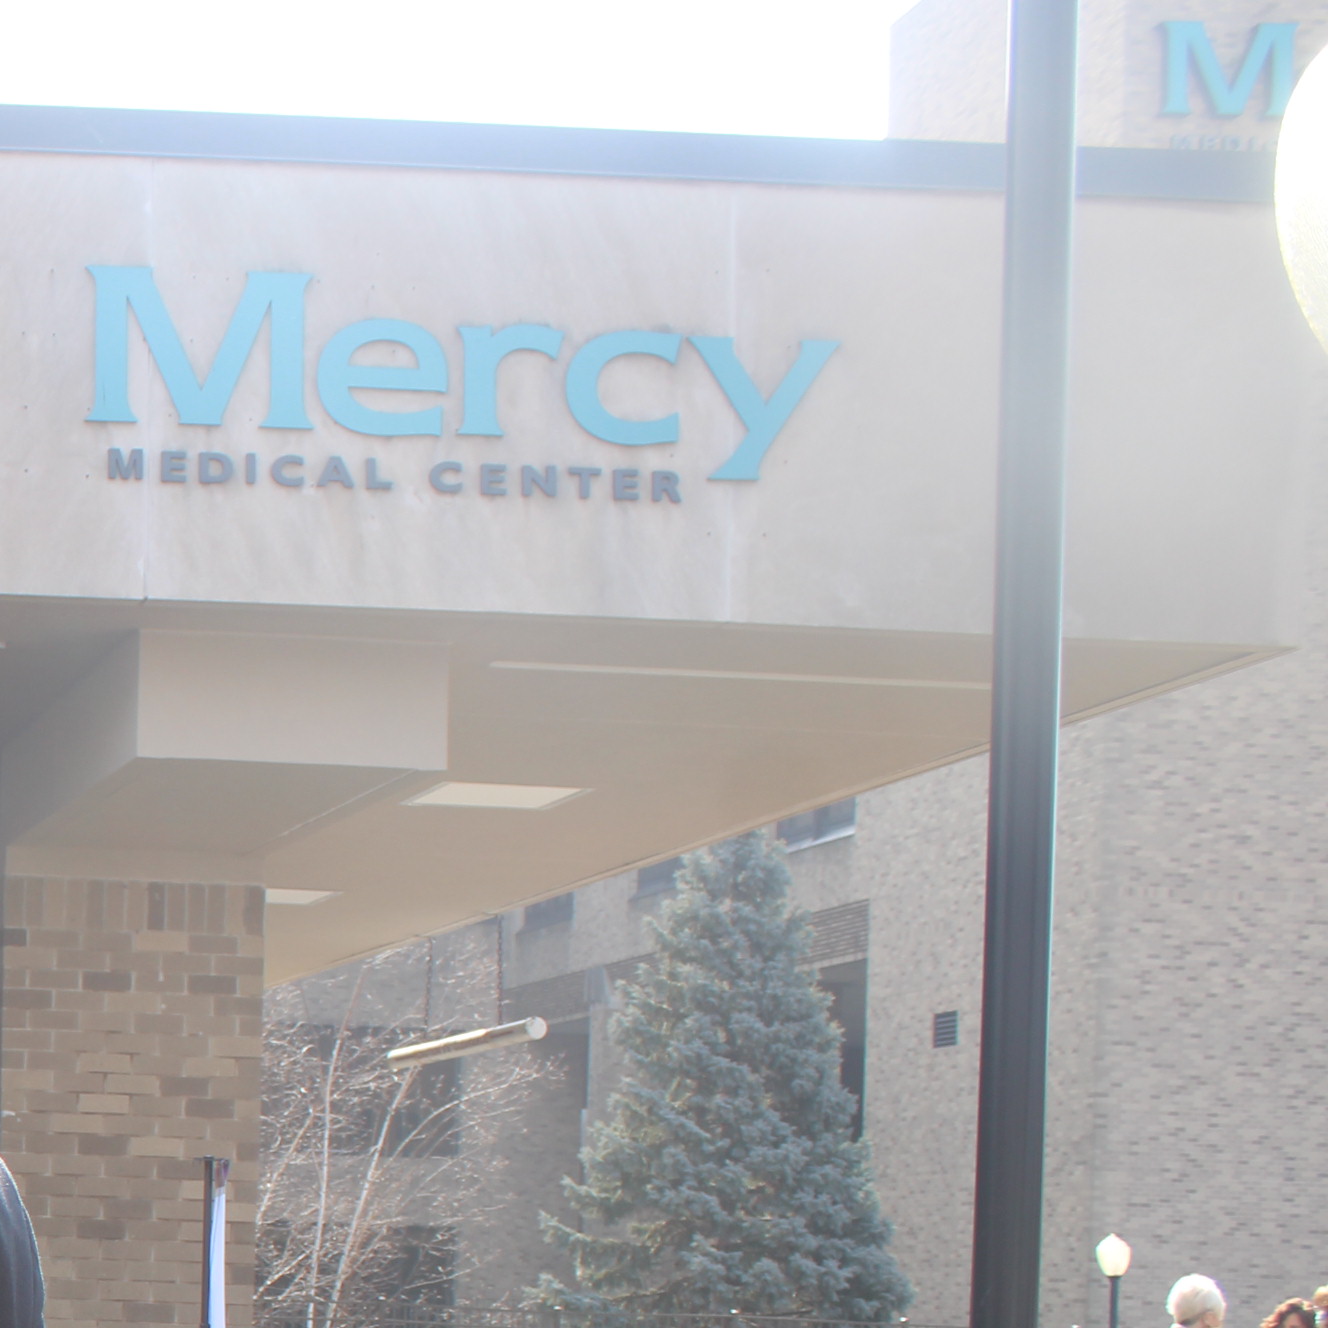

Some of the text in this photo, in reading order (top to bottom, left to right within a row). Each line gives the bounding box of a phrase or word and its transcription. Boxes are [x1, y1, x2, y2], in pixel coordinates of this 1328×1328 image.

[85, 263, 841, 481] Mercy
[106, 448, 682, 504] MEDICAL CENTER
